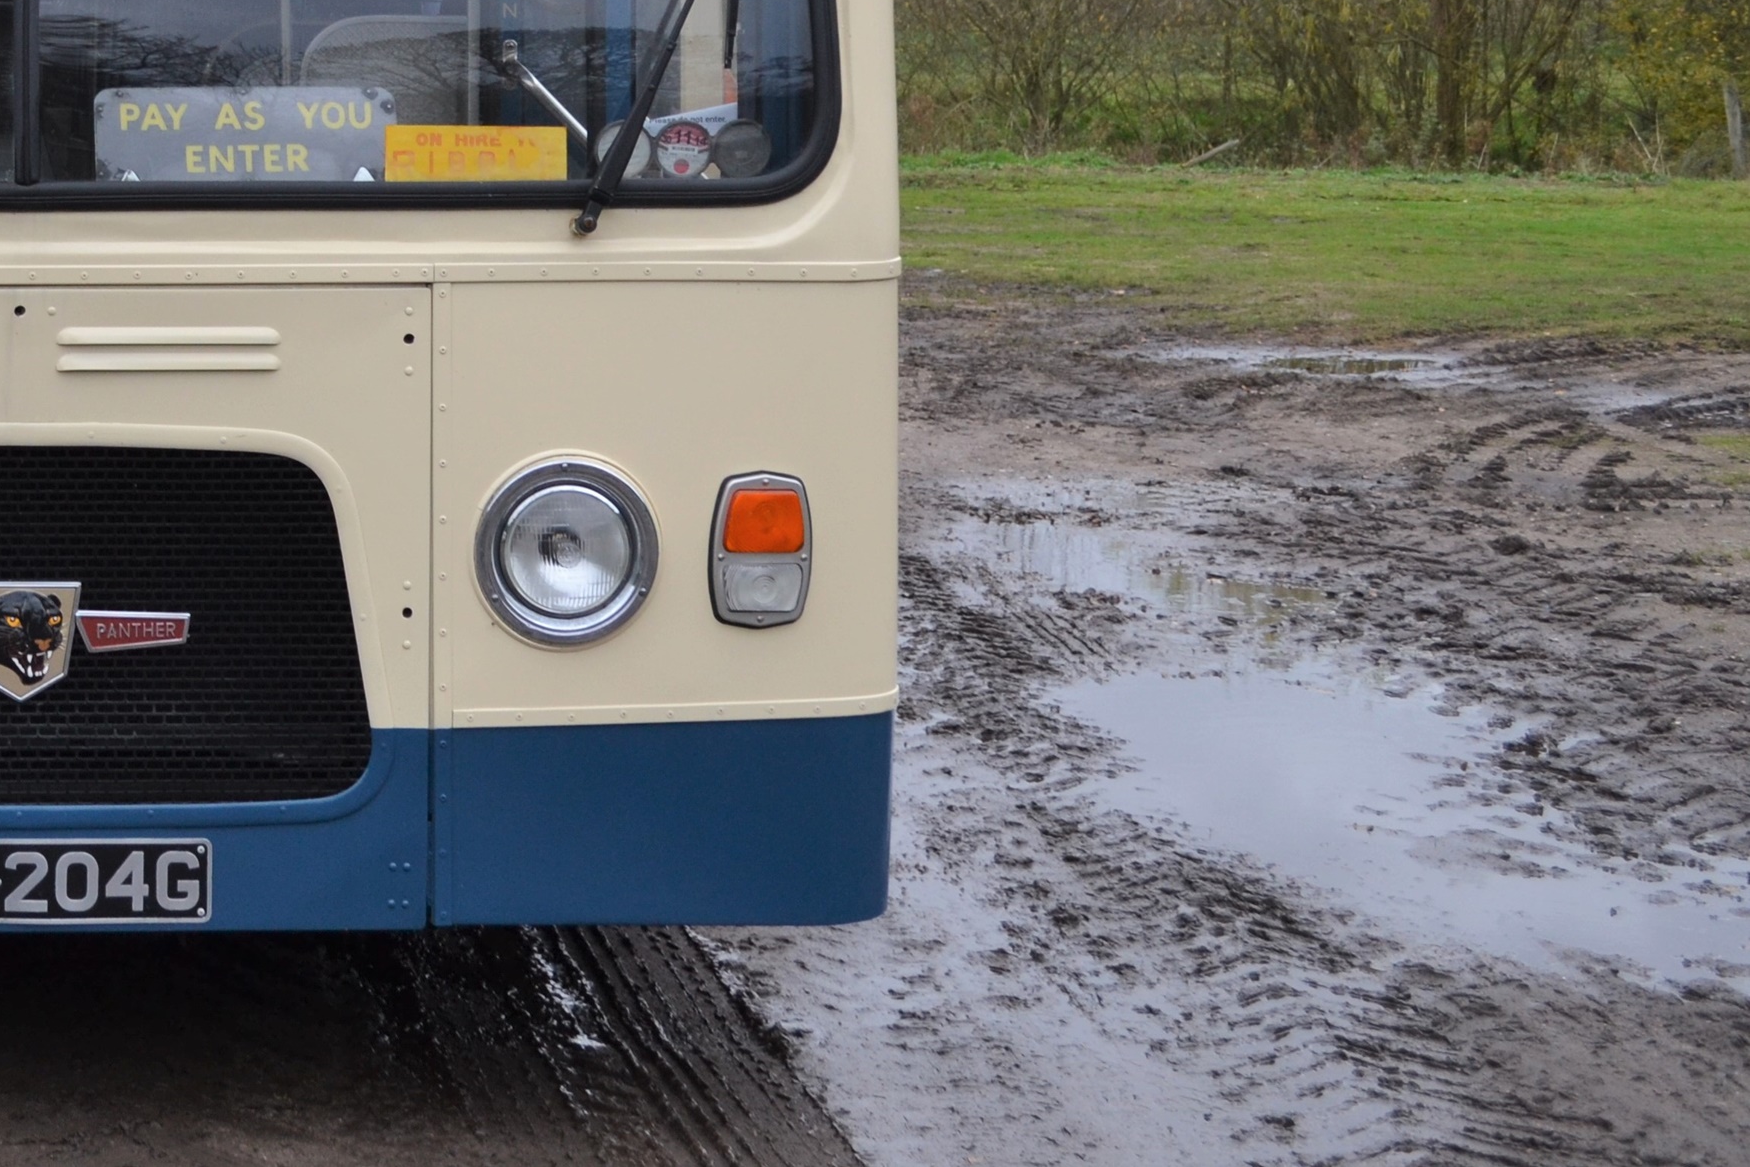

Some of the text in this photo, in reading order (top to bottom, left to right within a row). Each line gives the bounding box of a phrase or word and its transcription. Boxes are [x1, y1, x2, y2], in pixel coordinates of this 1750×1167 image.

[118, 101, 373, 131] PAY AS YOU
[415, 132, 442, 147] ON
[454, 133, 503, 148] HIRE
[675, 129, 692, 144] 11
[185, 143, 310, 173] ENTER
[95, 621, 177, 640] PANTHER
[4, 851, 201, 913] 204G
